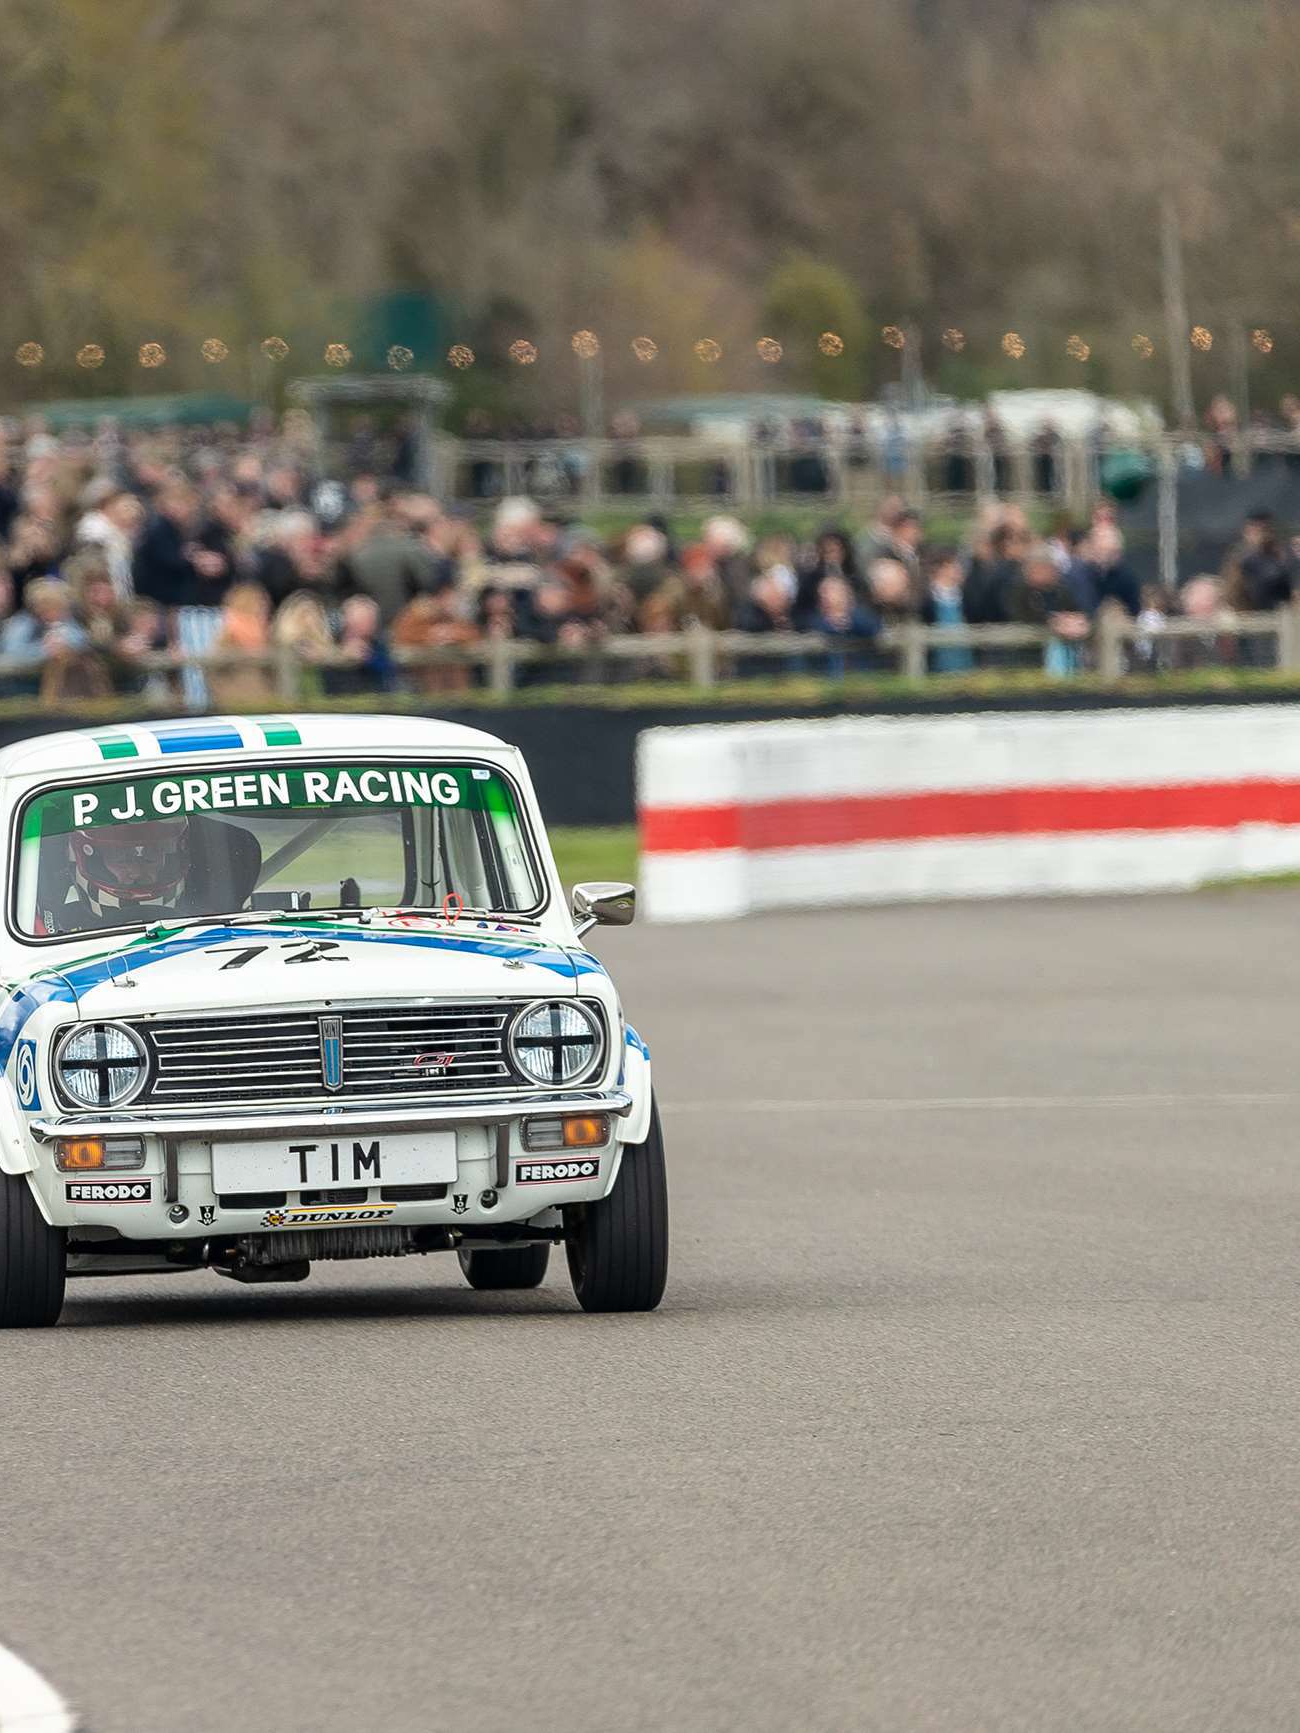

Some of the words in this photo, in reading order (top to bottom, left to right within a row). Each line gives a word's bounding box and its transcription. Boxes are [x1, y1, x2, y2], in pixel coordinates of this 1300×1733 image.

[73, 793, 99, 826] P.
[111, 786, 144, 820] J.
[152, 773, 290, 815] GREEN
[303, 769, 461, 805] RACING
[288, 1141, 381, 1183] TIM
[520, 1162, 595, 1180] FERODO
[70, 1184, 146, 1199] FERODO
[203, 1206, 212, 1225] TOW
[288, 1210, 393, 1223] DUNLOP
